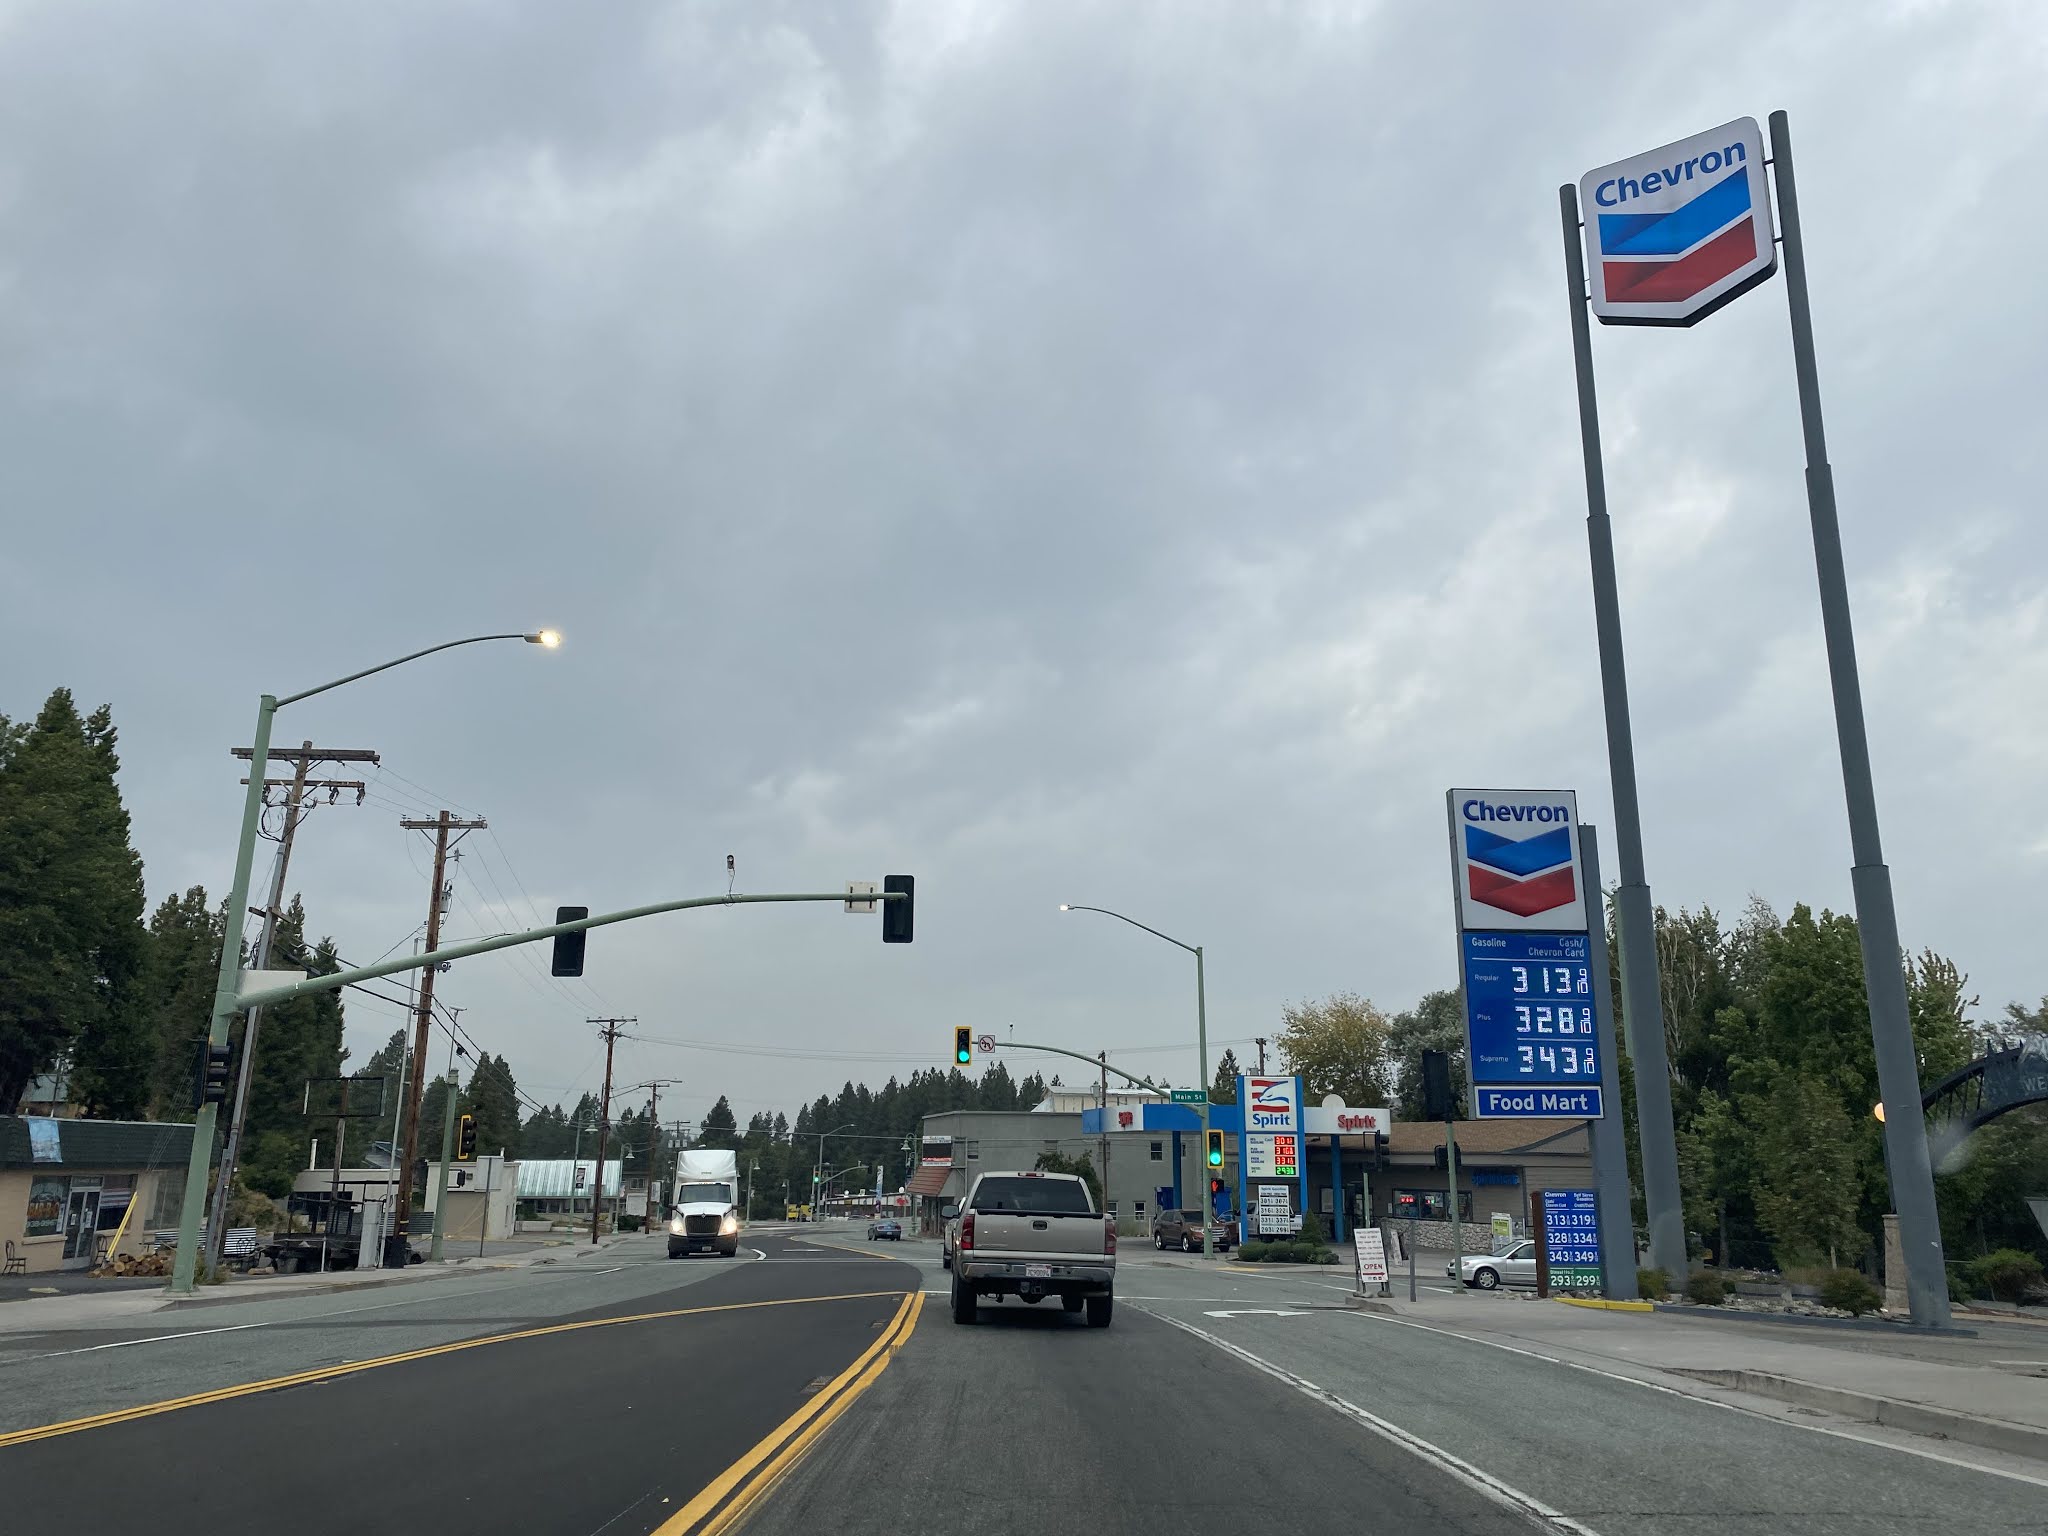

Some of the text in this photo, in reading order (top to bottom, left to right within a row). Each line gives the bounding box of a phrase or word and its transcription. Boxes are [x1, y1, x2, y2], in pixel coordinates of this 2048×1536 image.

[1595, 142, 1746, 206] Chevron
[1463, 799, 1569, 822] Chevron
[1471, 937, 1506, 947] Gasoline
[1559, 938, 1584, 948] Cash/
[1528, 947, 1585, 957] Chevron Card
[1474, 974, 1500, 982] Regular
[1512, 966, 1572, 994] 313
[1515, 1006, 1575, 1033] 328
[1480, 1055, 1509, 1063] Supreme
[1518, 1046, 1578, 1073] 343
[1489, 1093, 1589, 1111] Food Mart
[1252, 1113, 1291, 1128] Spirit
[1338, 1114, 1377, 1130] Spirit
[1546, 1215, 1566, 1225] 313
[1572, 1215, 1591, 1225] 319
[1548, 1233, 1567, 1243] 328
[1573, 1233, 1592, 1243] 334
[1549, 1251, 1569, 1261] 343
[1575, 1251, 1594, 1262] 349
[1551, 1275, 1571, 1286] 293
[1576, 1275, 1596, 1286] 299
